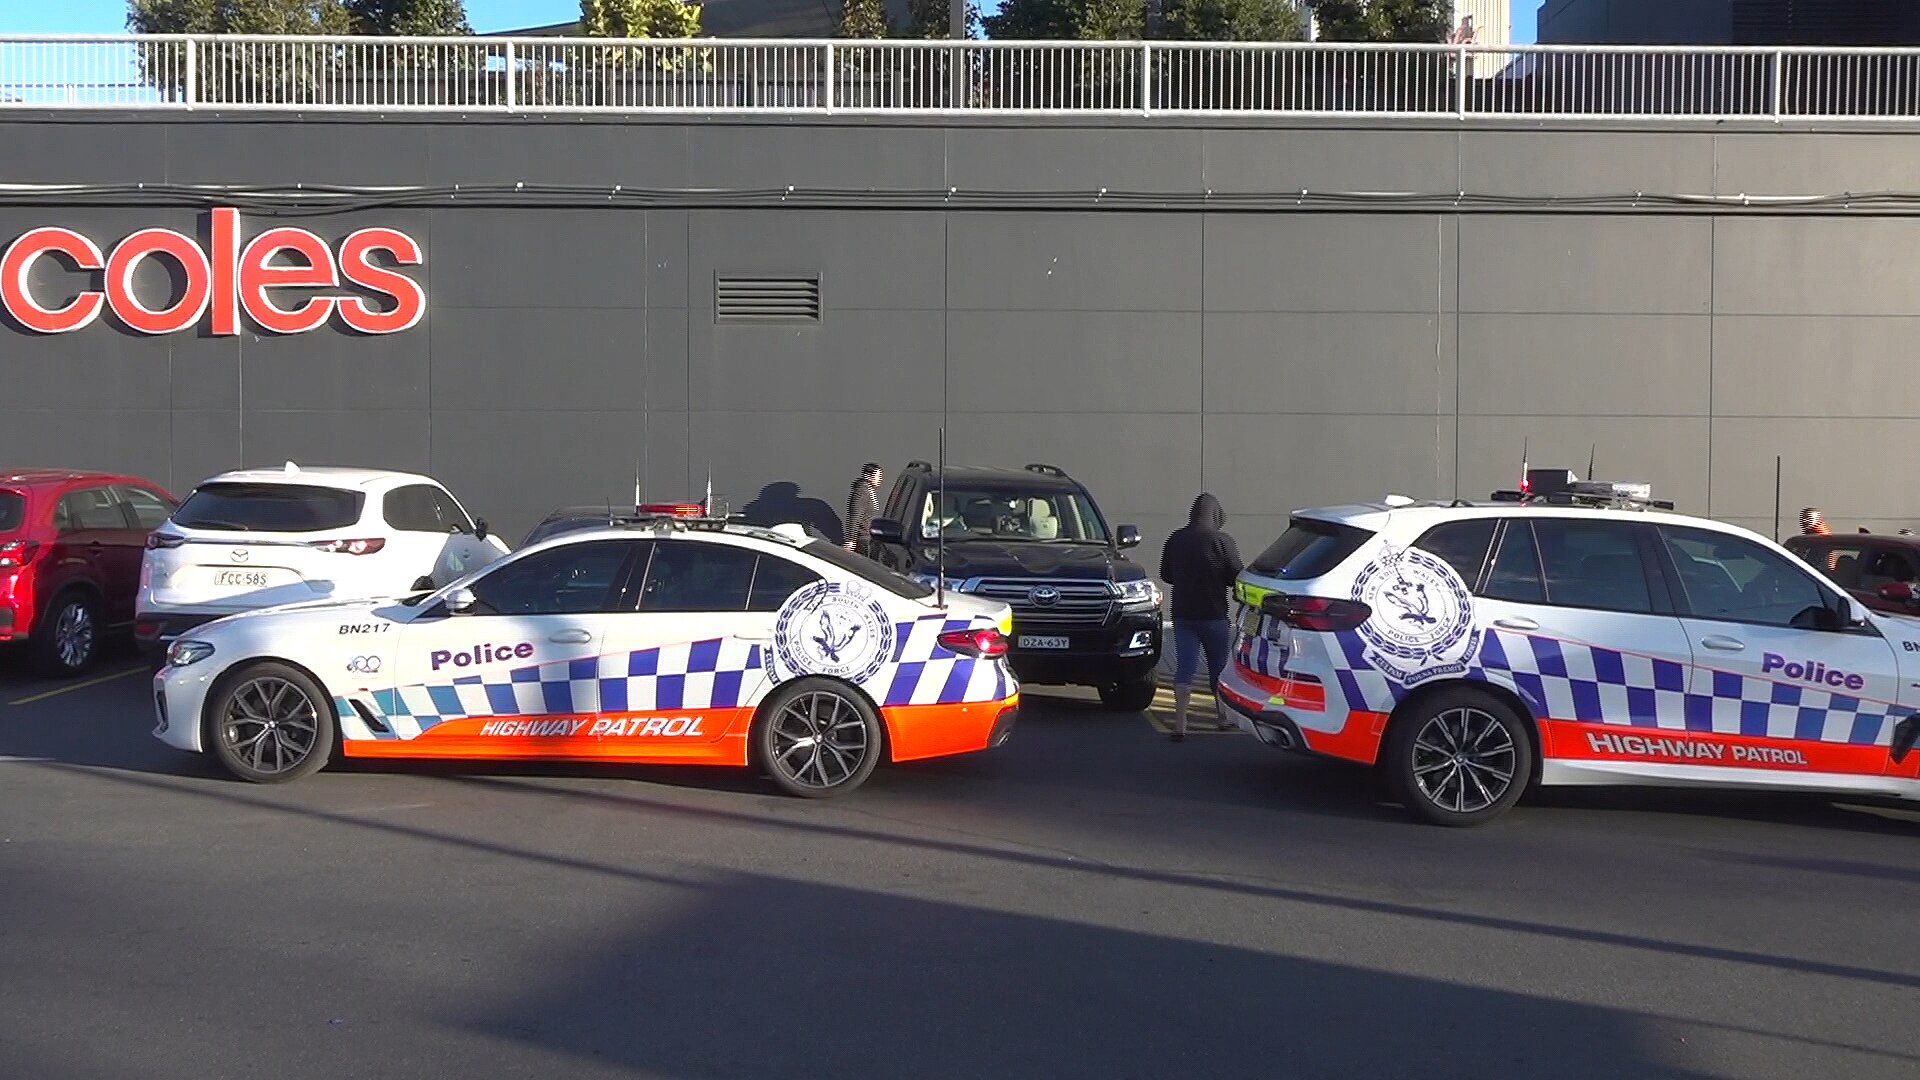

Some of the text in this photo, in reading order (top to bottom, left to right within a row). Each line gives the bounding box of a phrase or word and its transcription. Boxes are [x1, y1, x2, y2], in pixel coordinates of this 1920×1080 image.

[0, 207, 426, 334] coles
[339, 622, 391, 635] BN217
[1387, 629, 1420, 643] POLICE
[431, 640, 534, 671] Police
[793, 640, 850, 675] POLICE FORCE
[1761, 651, 1865, 691] Police
[480, 715, 705, 738] HIGHWAY PATROL
[1585, 732, 1808, 766] HIGHWAY PATROL
